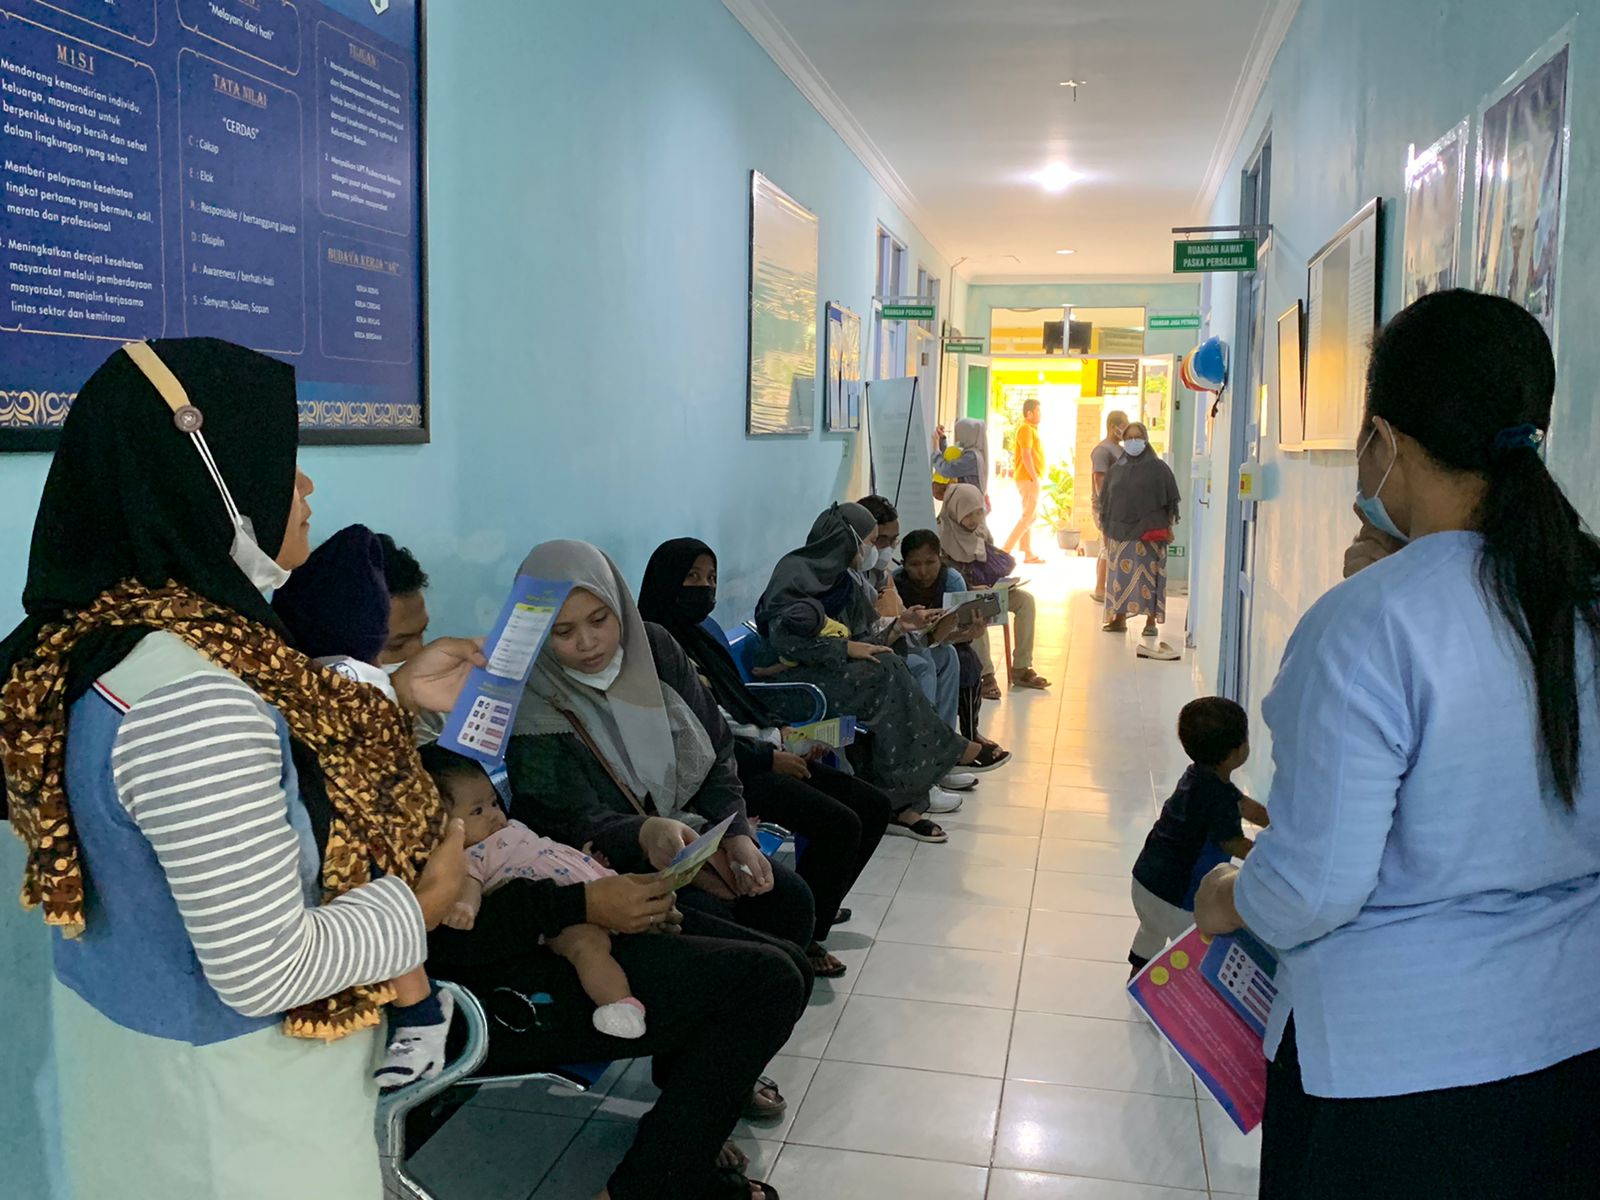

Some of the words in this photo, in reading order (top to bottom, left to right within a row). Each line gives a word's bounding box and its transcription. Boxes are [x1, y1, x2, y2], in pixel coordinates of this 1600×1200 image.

[244, 19, 258, 34] dari
[1, 58, 53, 87] Mendorong
[55, 75, 107, 102] kemandirian
[108, 93, 142, 115] individu,
[213, 73, 240, 96] TATA
[242, 85, 268, 106] NILAI
[2, 79, 46, 104] keluarga,
[48, 96, 96, 118] masyarakat
[99, 112, 121, 126] untuk
[3, 100, 55, 125] berperilaku
[57, 117, 81, 134] hidup
[84, 125, 108, 141] bersih
[110, 134, 125, 146] dan
[127, 138, 148, 152] sehat
[4, 122, 33, 139] dalam
[35, 131, 84, 153] lingkungan
[85, 147, 105, 161] yang
[107, 153, 128, 165] sehat
[199, 138, 219, 155] Cakap
[5, 160, 45, 179] Memberi
[47, 171, 92, 190] pelayanan
[94, 180, 133, 199] kesehatan
[6, 181, 38, 198] tingkat
[41, 191, 76, 206] pertama
[79, 199, 98, 213] yang
[101, 201, 135, 219] bermutu,
[7, 205, 39, 219] merata
[42, 210, 59, 221] dan
[61, 215, 112, 232] professional
[201, 201, 238, 220] Responsible
[243, 213, 279, 232] bertanggung
[9, 239, 72, 258] Meningkatkan
[74, 249, 103, 265] derajat
[105, 254, 144, 270] kesehatan
[328, 247, 359, 264] BUDAYA
[1183, 258, 1204, 267] PASKA
[1206, 257, 1248, 266] PERSALINAN
[1187, 245, 1219, 254] RUANGAN
[1220, 244, 1244, 253] RAWAT
[10, 261, 62, 277] masyarakat
[64, 268, 95, 281] melalui
[96, 274, 153, 291] pemberdayaan
[203, 265, 236, 280] Awareness
[11, 283, 65, 299] masyarakat,
[68, 289, 104, 304] menjalin
[105, 293, 144, 308] kerjasama
[251, 302, 270, 315] Sopan
[12, 300, 37, 313] lintas
[39, 304, 66, 317] sektor
[68, 307, 84, 318] dan
[86, 309, 126, 323] kemitraan
